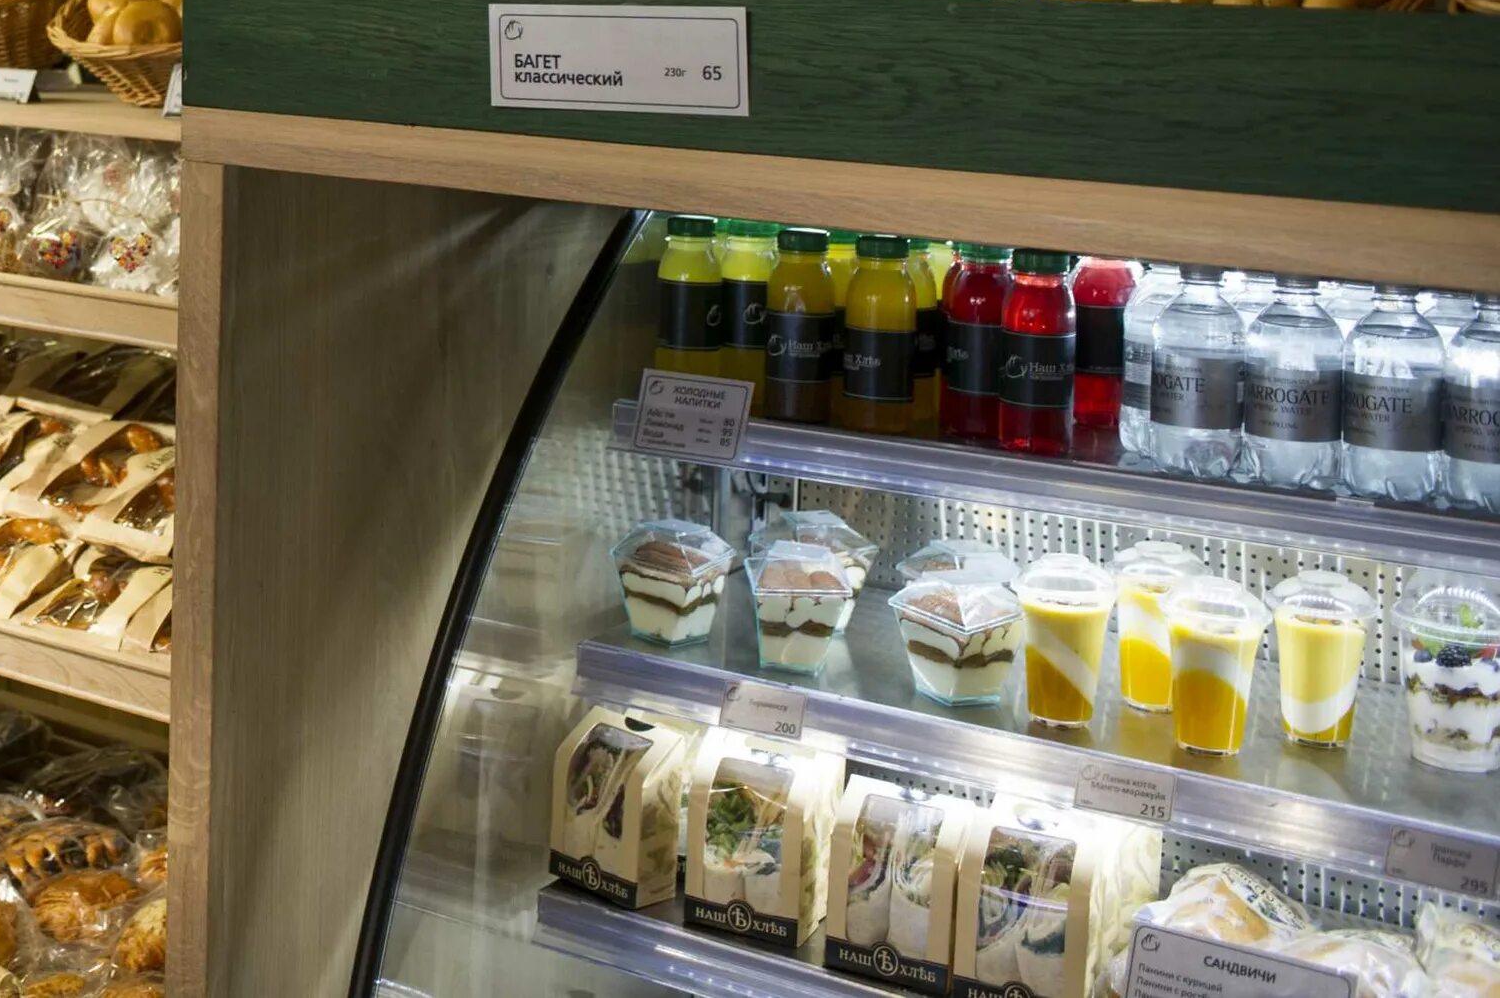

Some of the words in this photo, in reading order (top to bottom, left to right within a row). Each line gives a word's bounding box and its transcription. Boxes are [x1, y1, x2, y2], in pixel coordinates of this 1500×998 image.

[514, 53, 561, 70] БАГЕТ
[514, 70, 623, 87] классический
[664, 67, 687, 78] 230г
[702, 65, 722, 81] 65
[673, 386, 726, 400] ХОЛОДНЫЕ
[674, 396, 721, 410] НАПИТКИ
[775, 721, 797, 735] 200
[1140, 803, 1165, 819] 215
[558, 861, 582, 879] НАШ
[1460, 875, 1488, 894] 295
[695, 906, 727, 924] НАШ
[839, 948, 872, 967] НАШ
[1138, 962, 1175, 979] Панини
[1182, 976, 1223, 993] курицей
[1203, 955, 1277, 984] САНДВИЧИ
[1136, 975, 1173, 992] Панини
